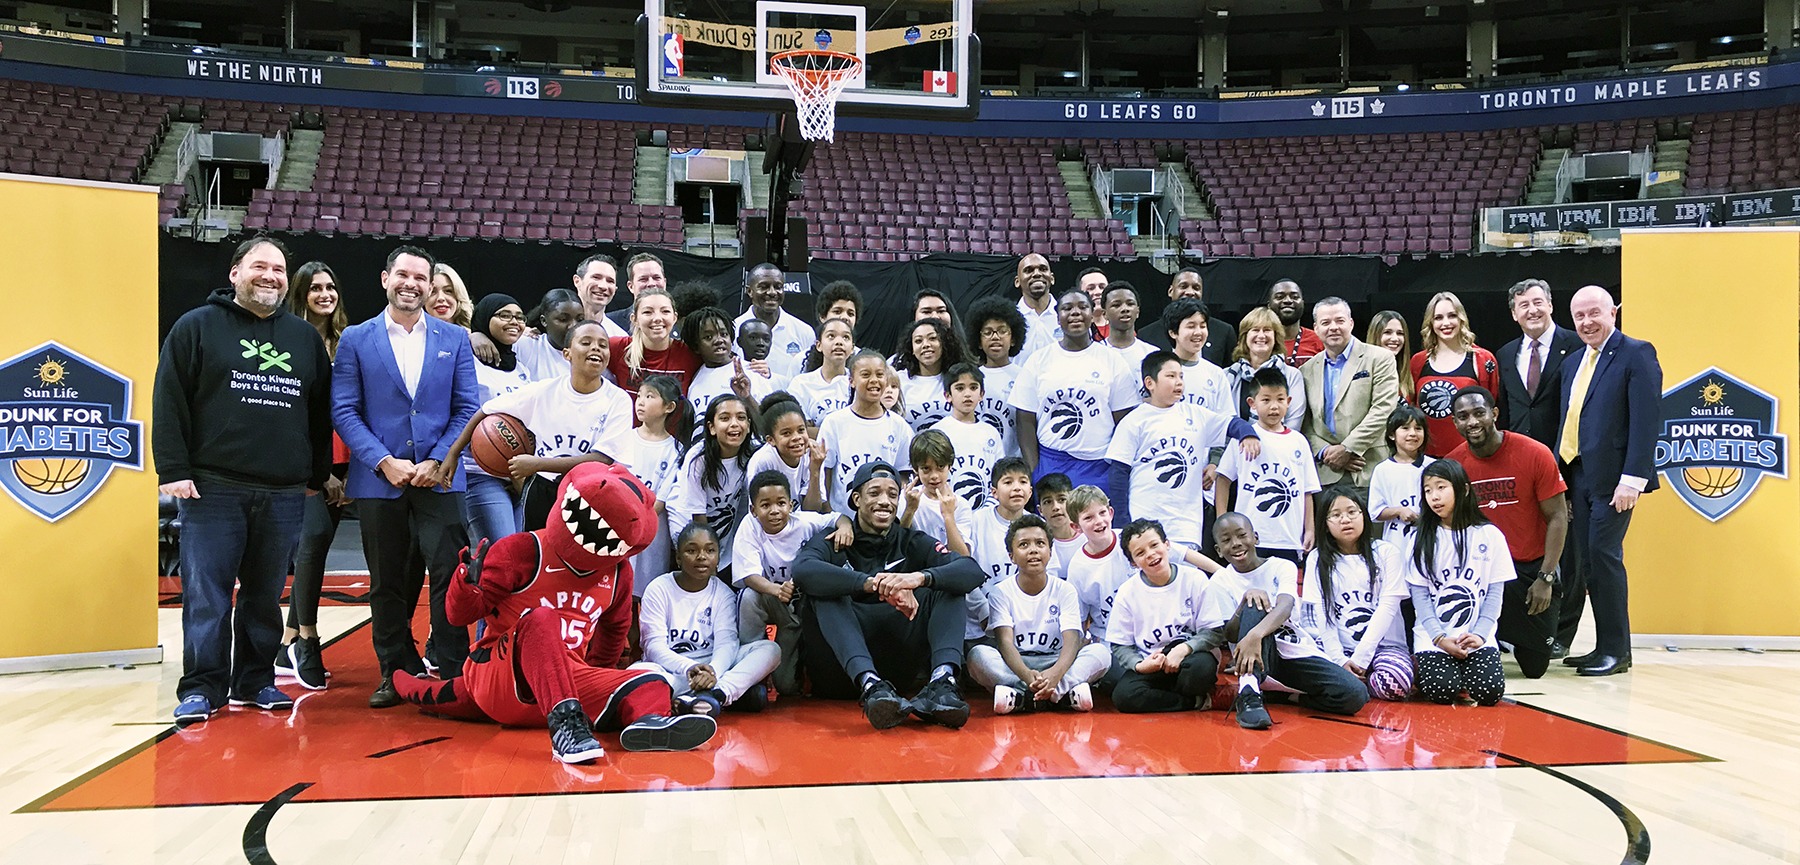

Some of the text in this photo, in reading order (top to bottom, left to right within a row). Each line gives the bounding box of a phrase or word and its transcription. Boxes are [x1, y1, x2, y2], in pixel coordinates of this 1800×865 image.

[187, 58, 322, 84] WE THE NORTH
[509, 80, 537, 95] 113
[658, 84, 691, 92] SPALDING
[1480, 71, 1762, 109] TORONTO MAPLE LEAFS
[1064, 103, 1196, 119] GO LEAFS GO
[1334, 101, 1361, 115] 115
[1618, 205, 1657, 223] IBM
[1732, 198, 1772, 216] IBM
[1562, 209, 1601, 225] IBM
[231, 370, 302, 387] Toronto Kiwanis
[1420, 380, 1458, 395] TORONTO
[23, 387, 79, 399] Sun Life
[230, 381, 301, 396] Boys & Girls Clubs
[1043, 387, 1101, 417] RAPTORS
[1420, 401, 1453, 418] RAPTOR
[1690, 406, 1735, 416] Sun Life
[0, 407, 104, 424] DUNK FOR
[495, 421, 520, 450] NCAA
[1671, 423, 1755, 438] DUNK FOR
[0, 425, 132, 458] IABETES
[537, 434, 592, 458] RAPTO
[1140, 436, 1198, 465] RAPTORS
[1655, 438, 1778, 468] DIABETES
[1243, 463, 1299, 498] RAPTORS
[520, 591, 602, 632] APTOR
[1334, 590, 1374, 620] RAPTO
[1016, 632, 1062, 650] PTOR
